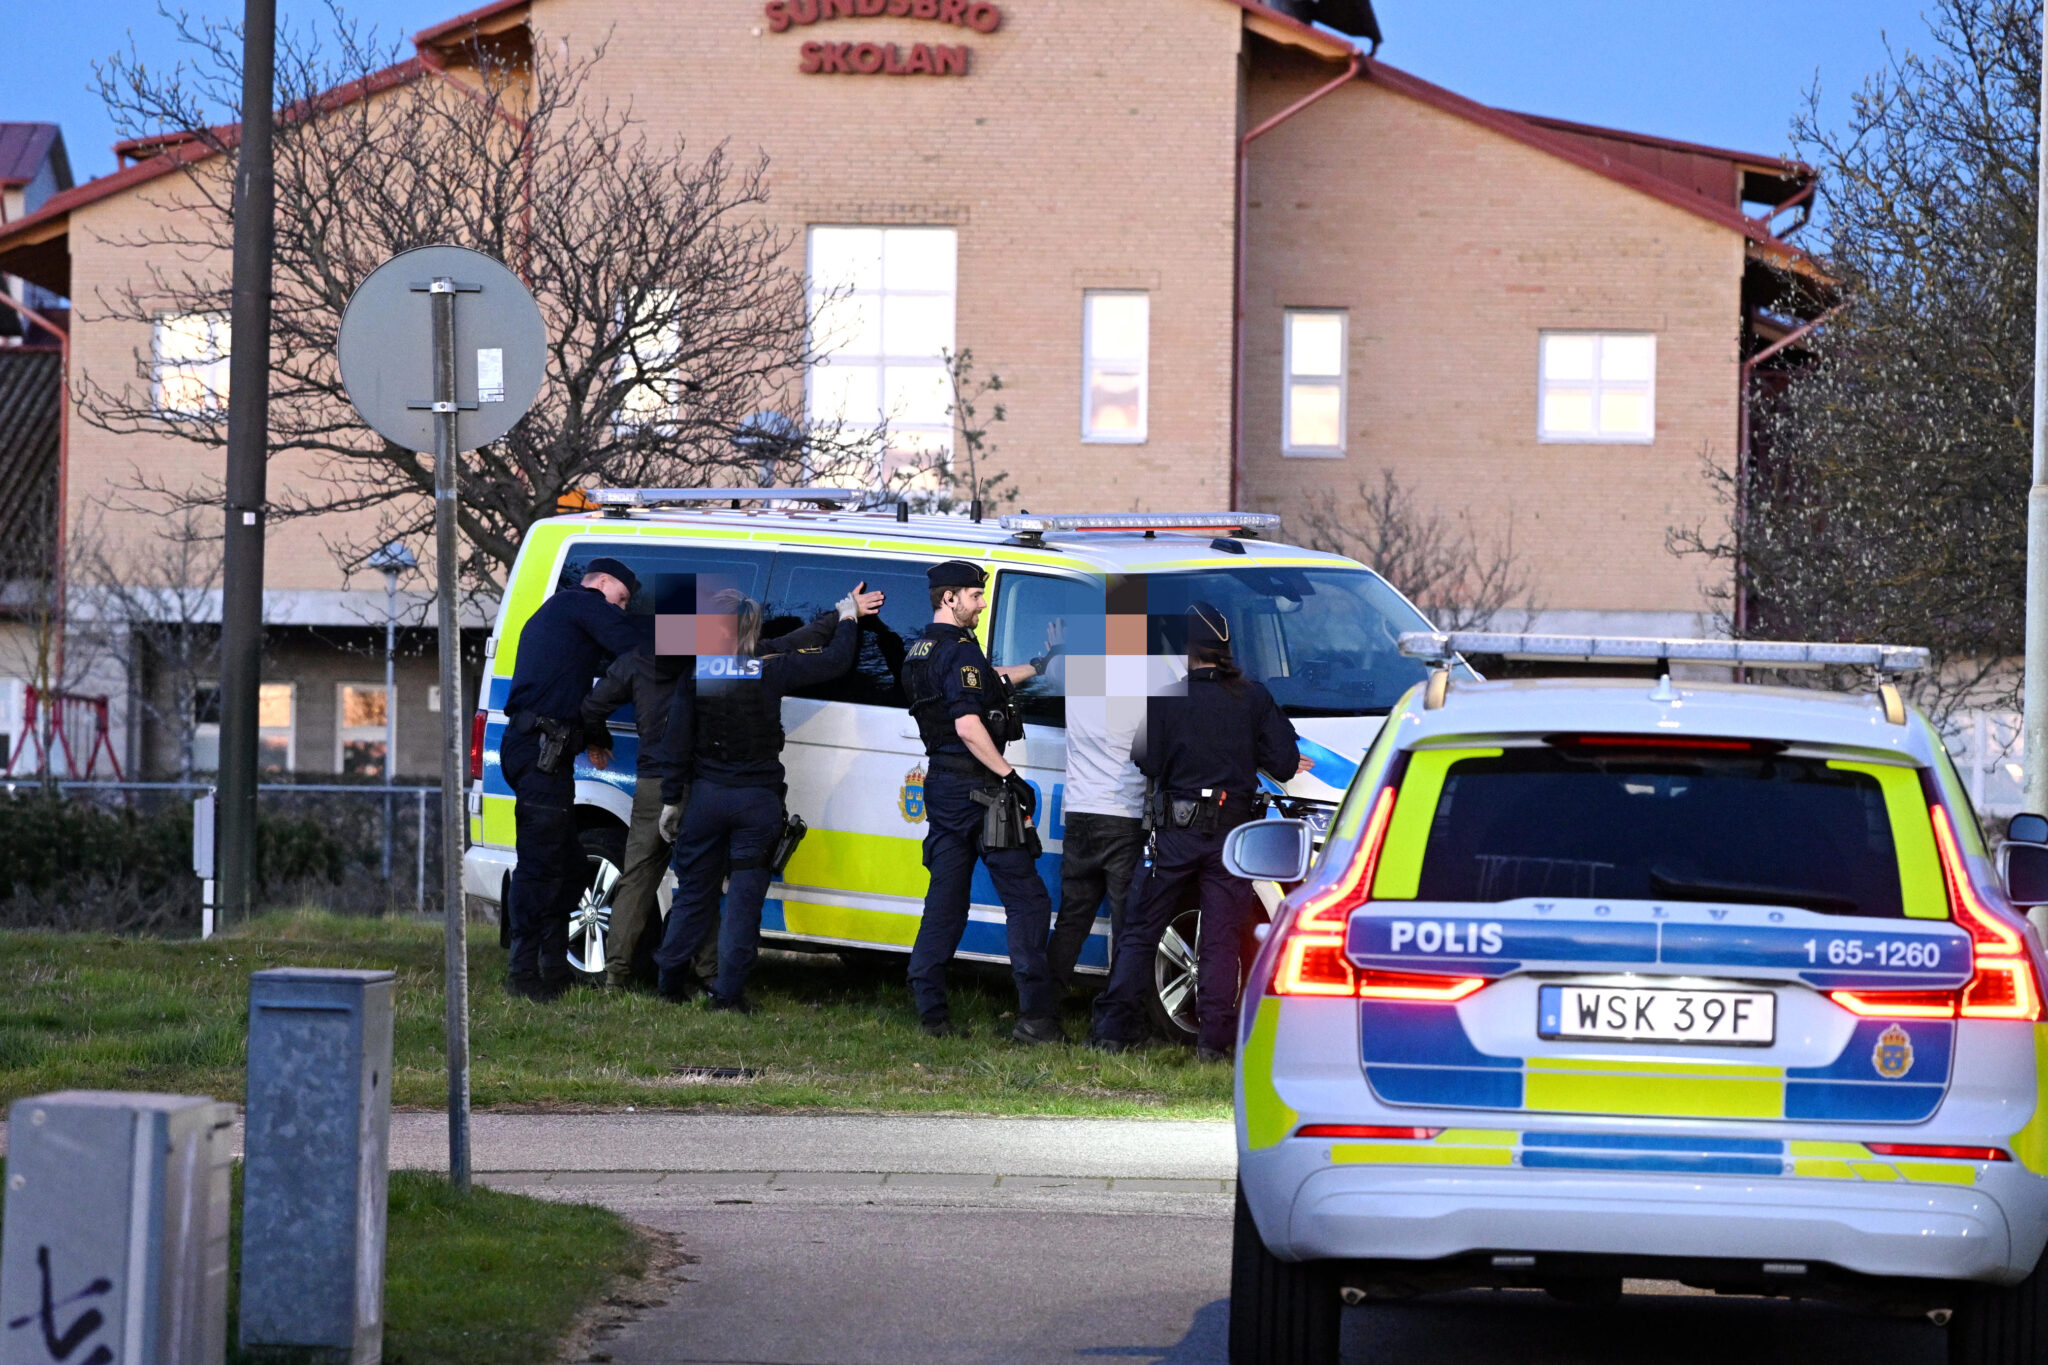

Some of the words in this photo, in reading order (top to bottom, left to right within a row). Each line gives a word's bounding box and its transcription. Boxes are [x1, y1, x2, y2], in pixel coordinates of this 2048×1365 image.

[799, 41, 969, 76] SKOLAN
[1533, 902, 1785, 923] VOLVO
[1390, 920, 1504, 954] POLIS
[1803, 938, 1817, 964] 1
[1827, 939, 1941, 968] 65-1260
[1577, 993, 1656, 1031] WSK
[1673, 997, 1754, 1034] 39F
